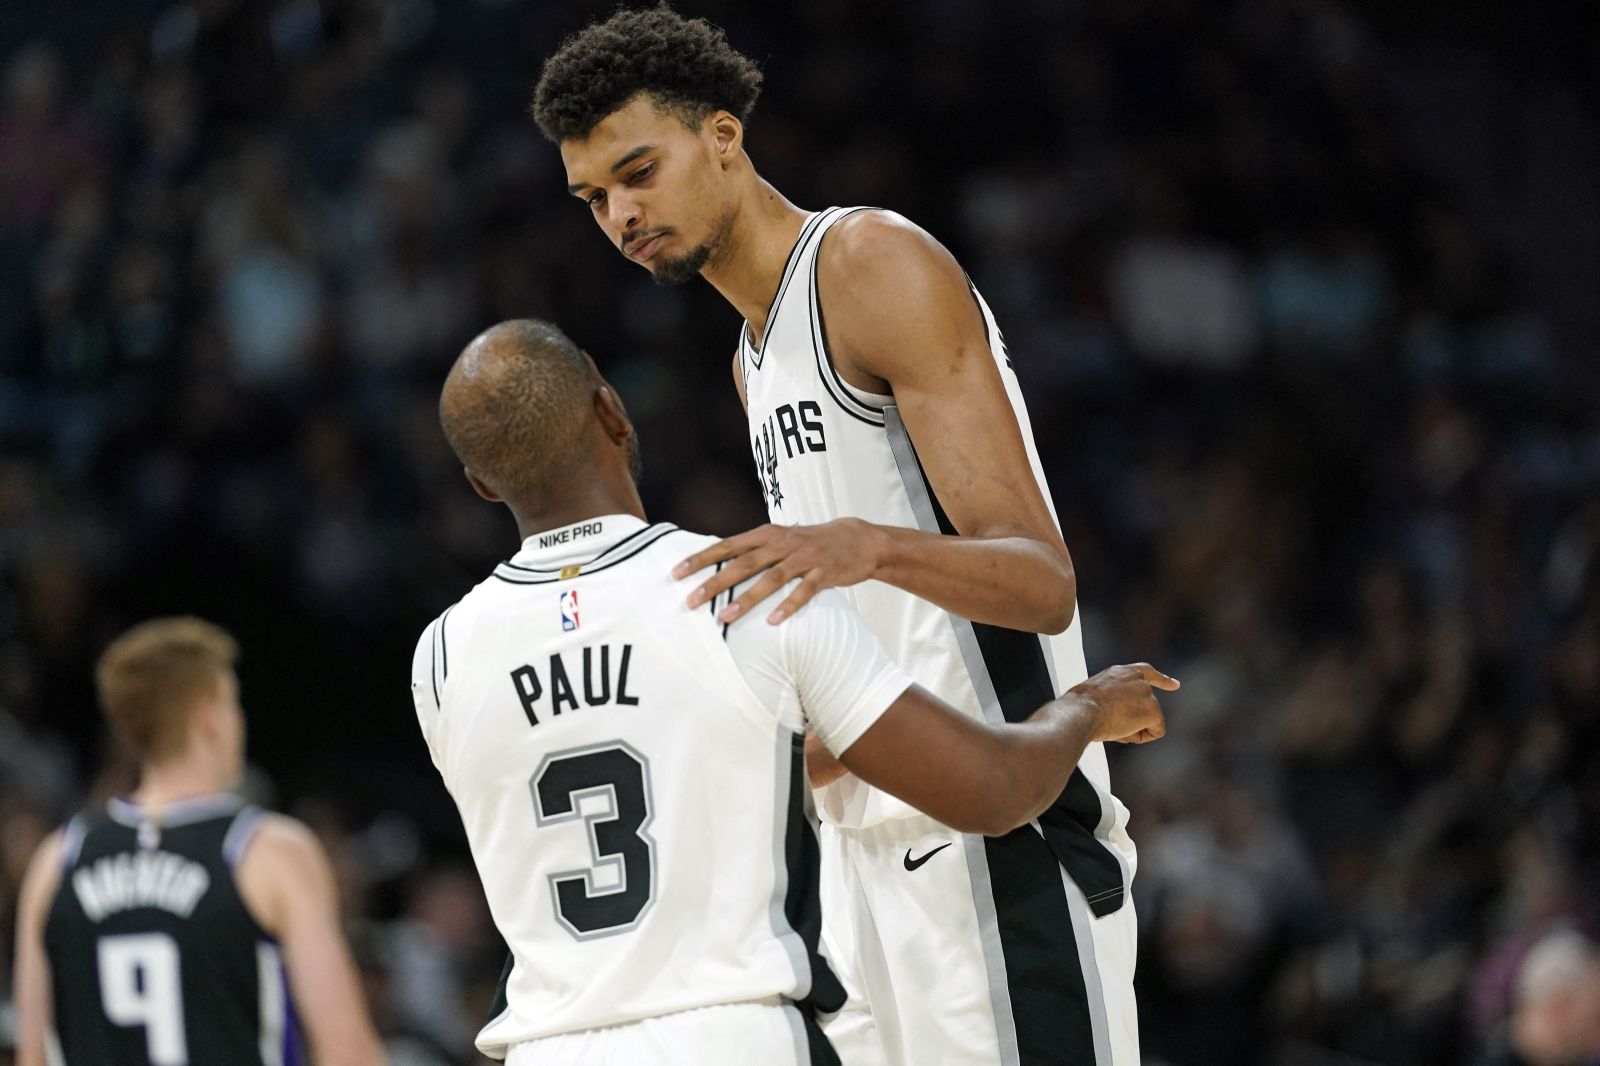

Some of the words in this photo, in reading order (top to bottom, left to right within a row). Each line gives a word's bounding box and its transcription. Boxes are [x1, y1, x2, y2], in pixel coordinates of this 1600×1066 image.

[755, 400, 827, 506] PURS
[539, 530, 570, 549] NIKE
[572, 521, 603, 540] PRO
[510, 644, 639, 727] PAUL
[528, 738, 658, 943] 3
[97, 931, 188, 1066] 9
